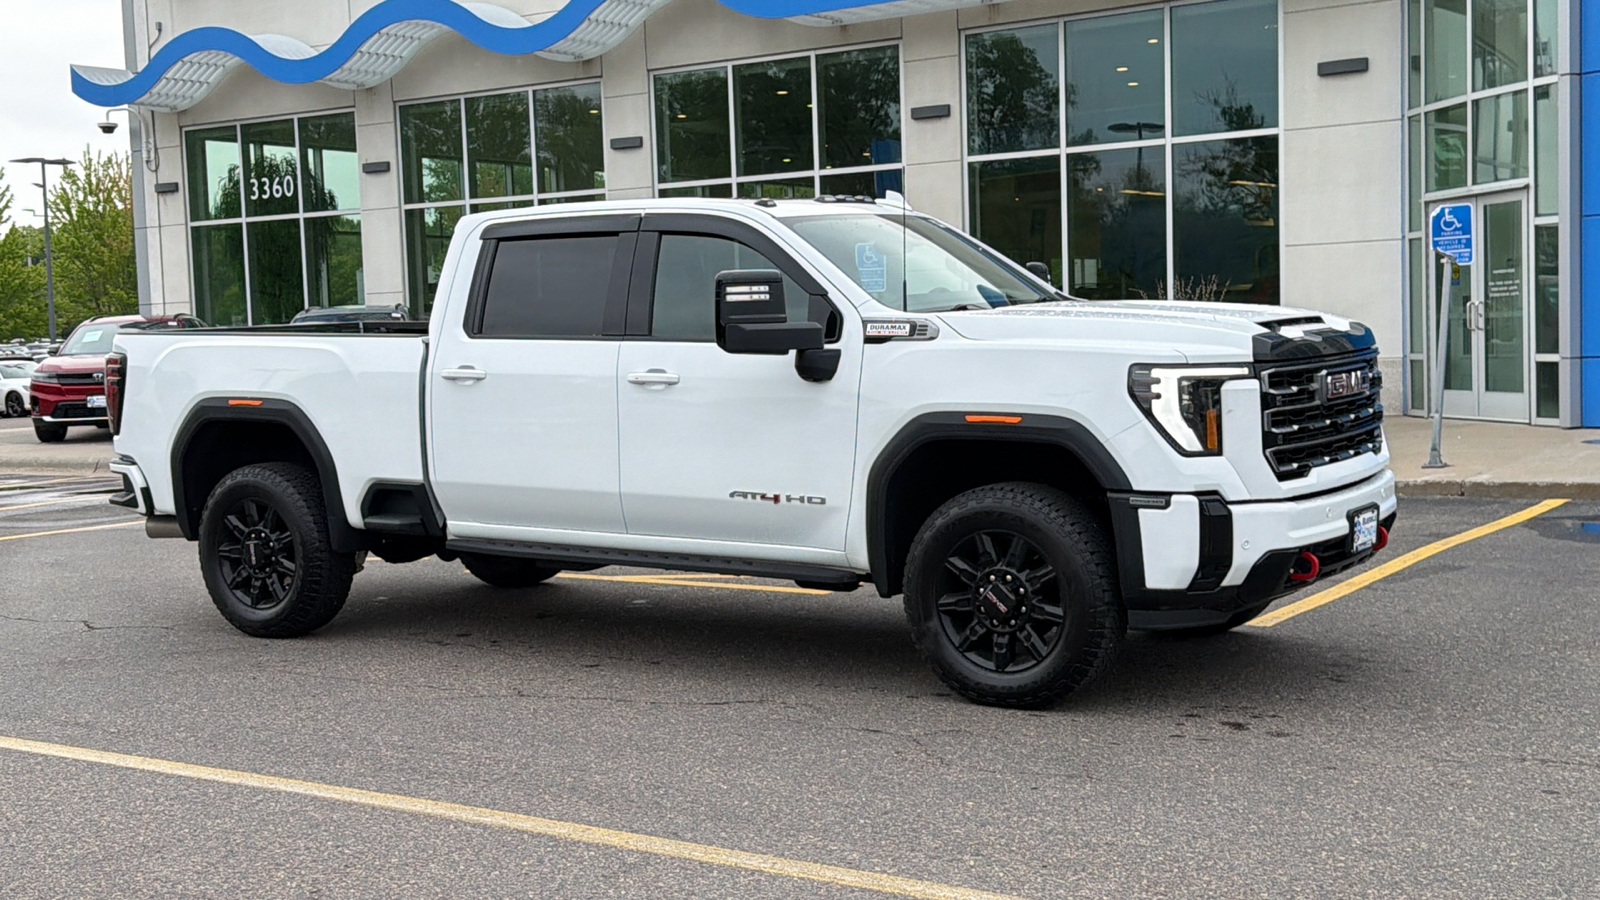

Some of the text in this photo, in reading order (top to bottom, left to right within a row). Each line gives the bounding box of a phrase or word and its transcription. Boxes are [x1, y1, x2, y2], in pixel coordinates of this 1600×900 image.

[250, 175, 294, 200] 3360
[1327, 370, 1370, 398] GMC
[729, 490, 827, 505] AT4 HD
